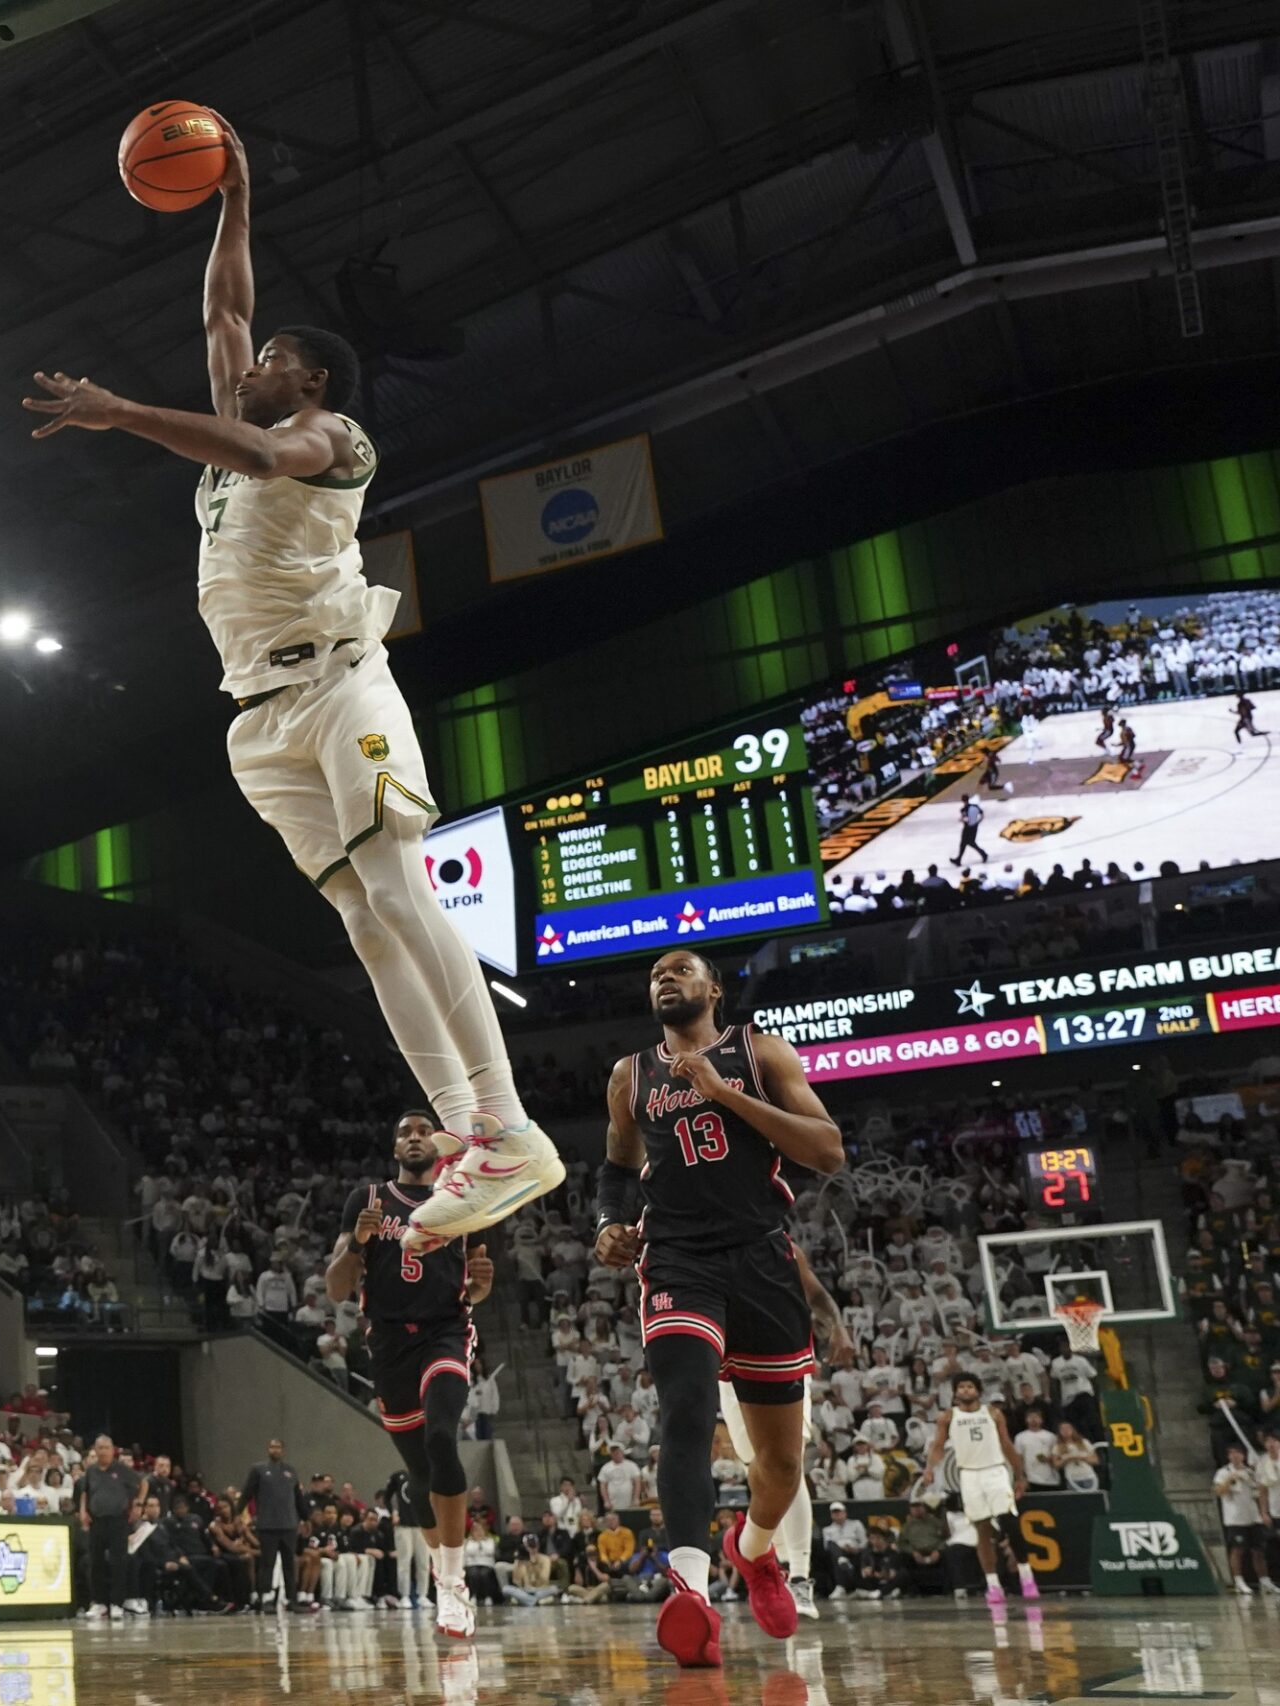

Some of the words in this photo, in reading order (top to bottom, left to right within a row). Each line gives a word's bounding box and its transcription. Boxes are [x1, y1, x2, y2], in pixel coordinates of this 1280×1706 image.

[643, 755, 724, 790] BAYLOR
[733, 728, 790, 773] 39
[592, 791, 601, 802] 2
[661, 794, 680, 806] PTS
[696, 787, 715, 799] REB
[733, 780, 752, 792] AST
[773, 774, 787, 785] PF
[539, 817, 556, 828] THE
[541, 849, 549, 861] 3
[560, 840, 602, 858] ROACH
[670, 826, 678, 838] 2
[743, 813, 751, 824] 1
[782, 806, 789, 818] 1
[558, 824, 607, 843] WRIGHT
[668, 811, 677, 822] 3
[704, 804, 712, 816] 2
[741, 797, 750, 809] 2
[779, 790, 787, 802] 1
[542, 863, 551, 875] 7
[562, 849, 637, 872] EDGECOMBE
[672, 840, 680, 852] 9
[708, 834, 717, 846] 3
[745, 828, 753, 840] 1
[783, 821, 791, 833] 1
[563, 869, 603, 886] OMIER
[671, 855, 685, 868] 11
[747, 843, 755, 854] 1
[786, 836, 794, 848] 1
[542, 892, 557, 904] 32
[564, 879, 632, 901] CELESTINE
[675, 871, 684, 883] 3
[712, 865, 721, 877] 3
[788, 852, 795, 864] 1
[707, 898, 776, 923] American
[777, 892, 817, 912] Bank
[567, 923, 631, 946] American
[632, 915, 669, 935] Bank
[999, 972, 1097, 1006] TEXAS
[1099, 960, 1185, 992] FARM
[753, 989, 915, 1028] CHAMPIONSHIP
[1053, 1007, 1146, 1046] 13:27
[1156, 1017, 1201, 1035] HALF
[1158, 1005, 1194, 1021] 2ND
[815, 1052, 840, 1071] AT
[845, 1046, 892, 1067] OUR
[896, 1037, 959, 1061] GRAB
[964, 1034, 981, 1052] &
[985, 1028, 1020, 1049] GO
[674, 1111, 729, 1167] 13
[1040, 1148, 1090, 1171] 13:27
[1043, 1169, 1090, 1206] 27
[400, 1246, 423, 1283] 5
[969, 1427, 983, 1441] 15
[1098, 1559, 1126, 1571] Your
